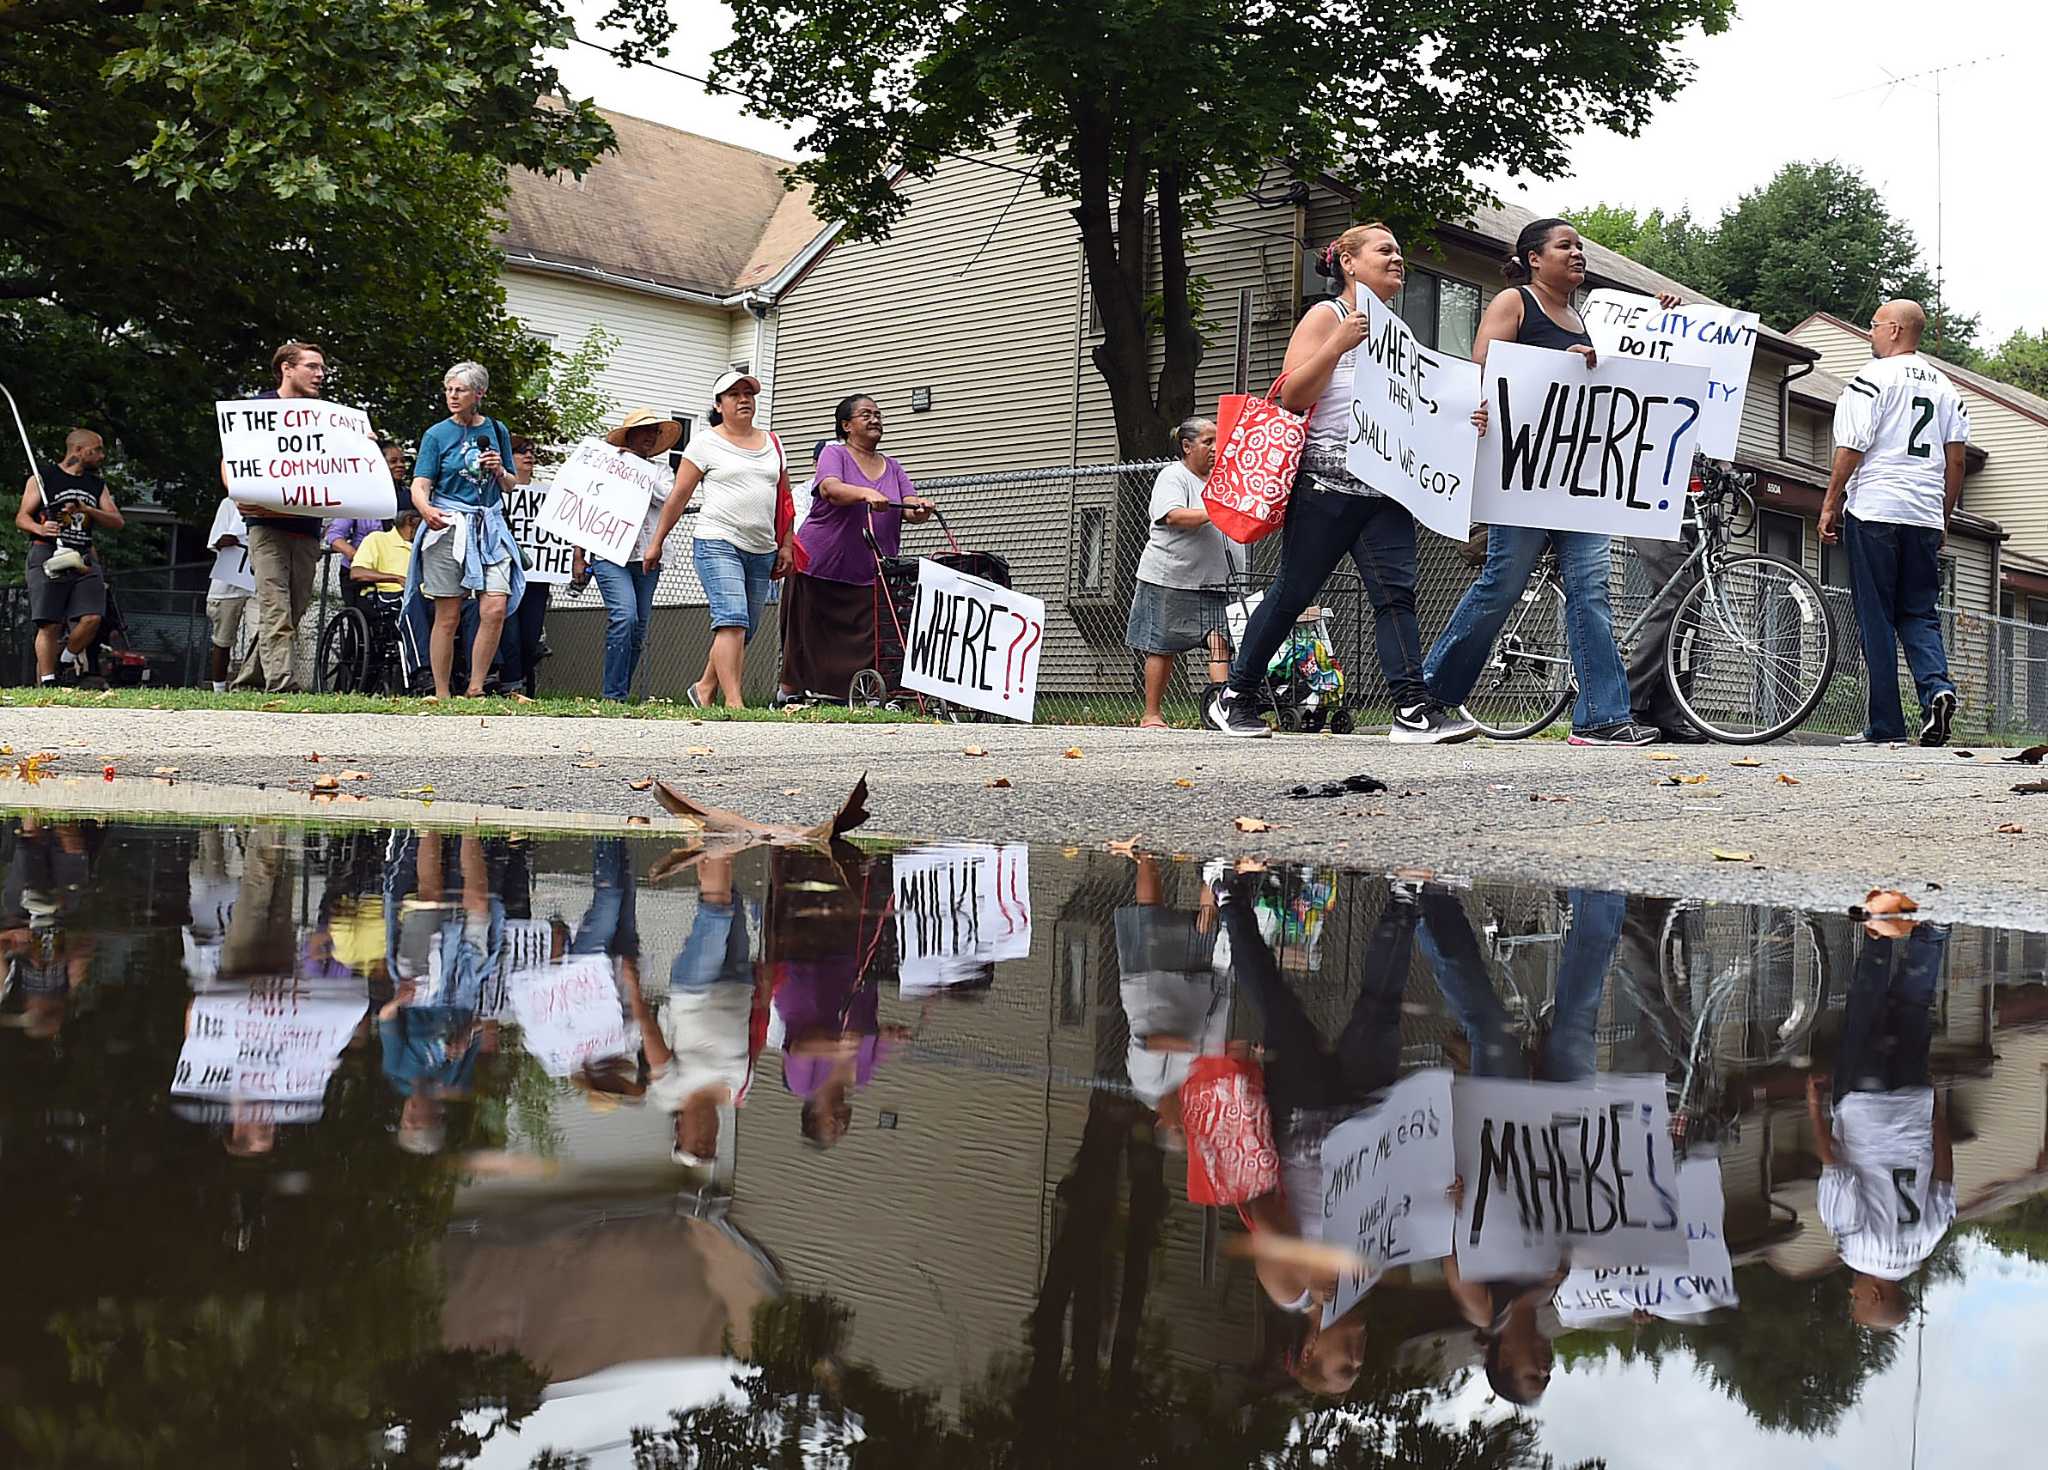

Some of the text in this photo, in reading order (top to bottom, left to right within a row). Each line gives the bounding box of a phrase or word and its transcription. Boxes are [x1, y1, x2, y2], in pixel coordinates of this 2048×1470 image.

[1604, 301, 1648, 328] THE
[1646, 313, 1697, 338] CITY
[1367, 298, 1440, 414] WHERE,
[1619, 336, 1673, 362] DO IT,
[1905, 367, 1937, 384] TEAM
[221, 410, 366, 434] IF THE CITY CAN'T
[1907, 396, 1934, 458] 2
[278, 433, 326, 454] DO IT,
[1350, 400, 1460, 501] SHALL WE GO?
[1498, 377, 1700, 510] WHERE?
[227, 457, 376, 478] THE COMMUNITY
[592, 452, 656, 495] EMERGENCY
[281, 486, 342, 507] WILL
[586, 480, 605, 496] IS
[552, 488, 635, 550] TONIGHT
[911, 583, 1041, 700] WHERE??
